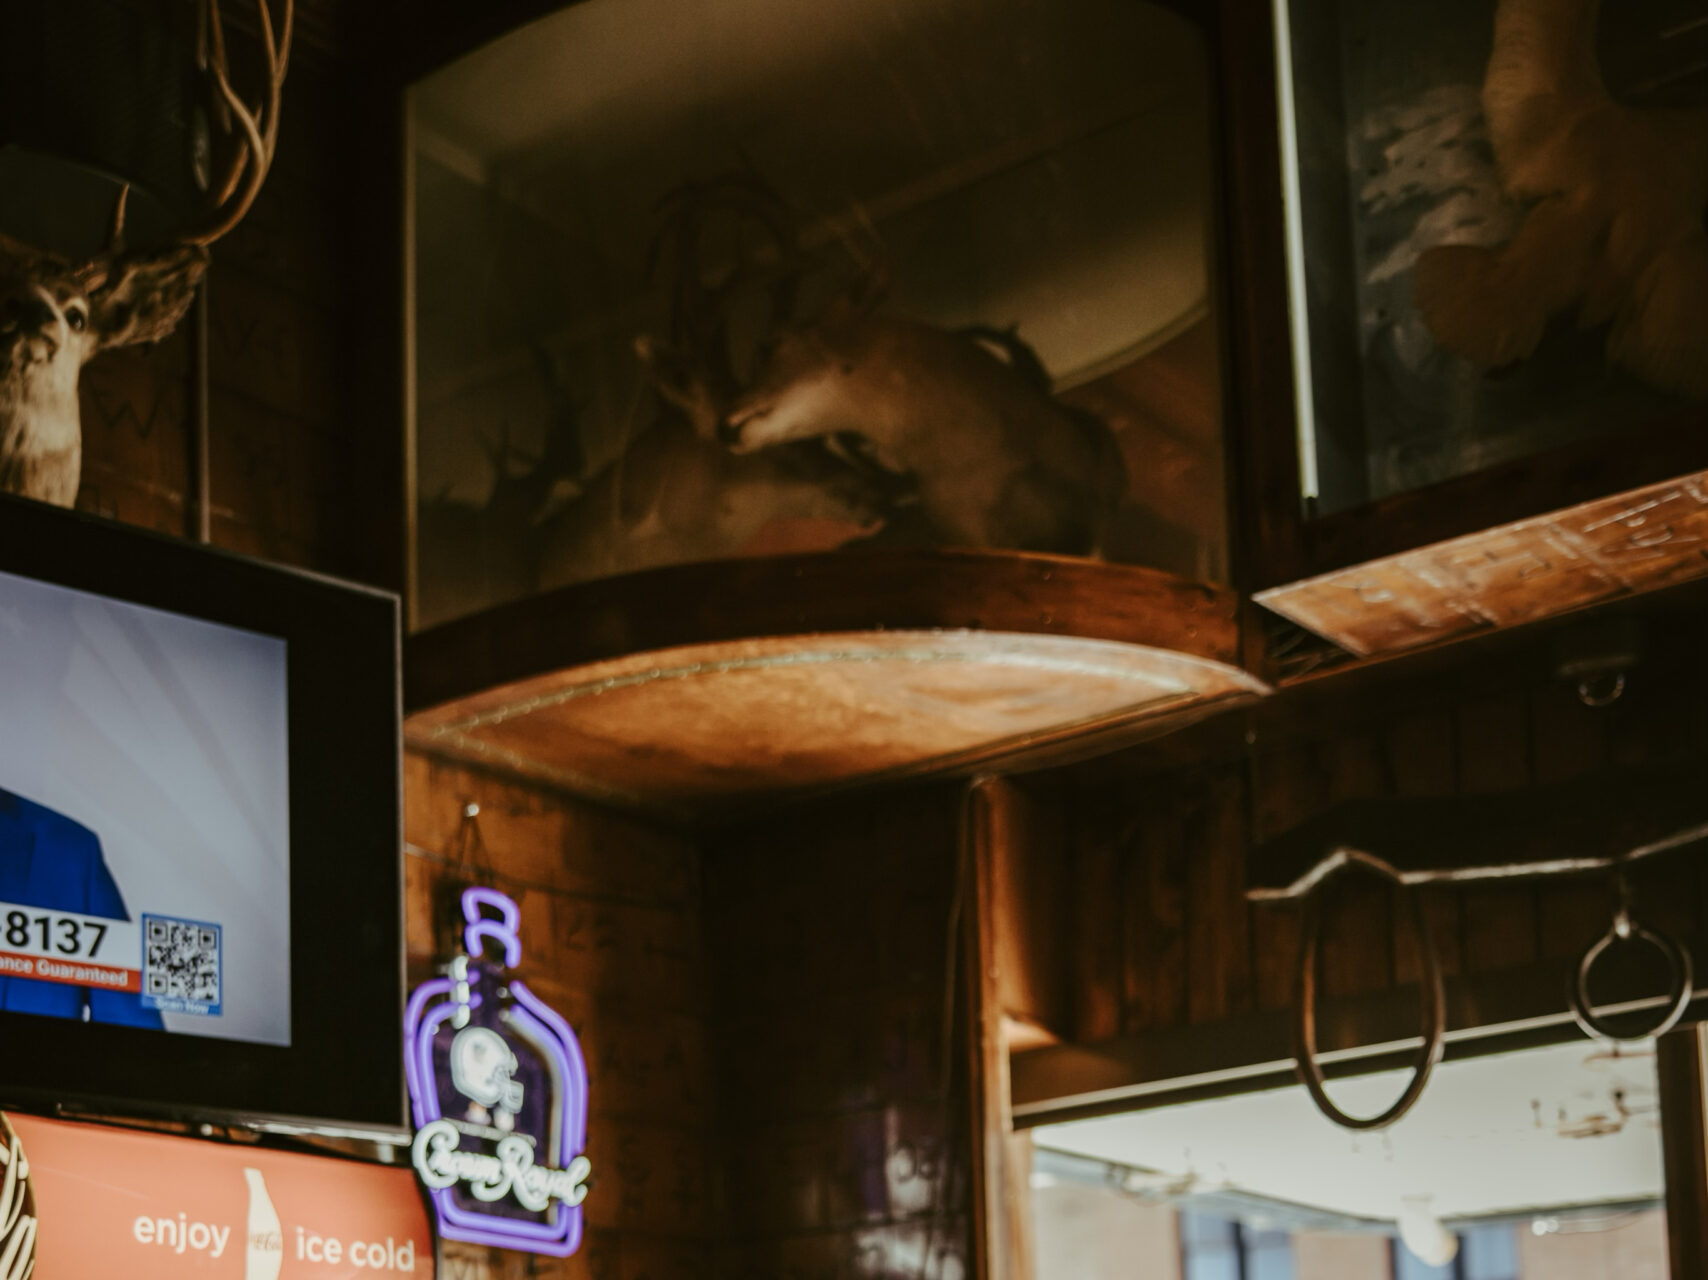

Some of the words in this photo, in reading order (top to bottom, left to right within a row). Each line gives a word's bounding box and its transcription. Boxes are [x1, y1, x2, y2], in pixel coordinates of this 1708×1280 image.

[0, 911, 109, 958] 8137
[37, 959, 128, 986] Guaranteed
[412, 1120, 501, 1189] Crown
[471, 1136, 591, 1212] Royal
[133, 1212, 230, 1258] enjoy
[297, 1226, 342, 1264] ice
[349, 1237, 415, 1272] cold
